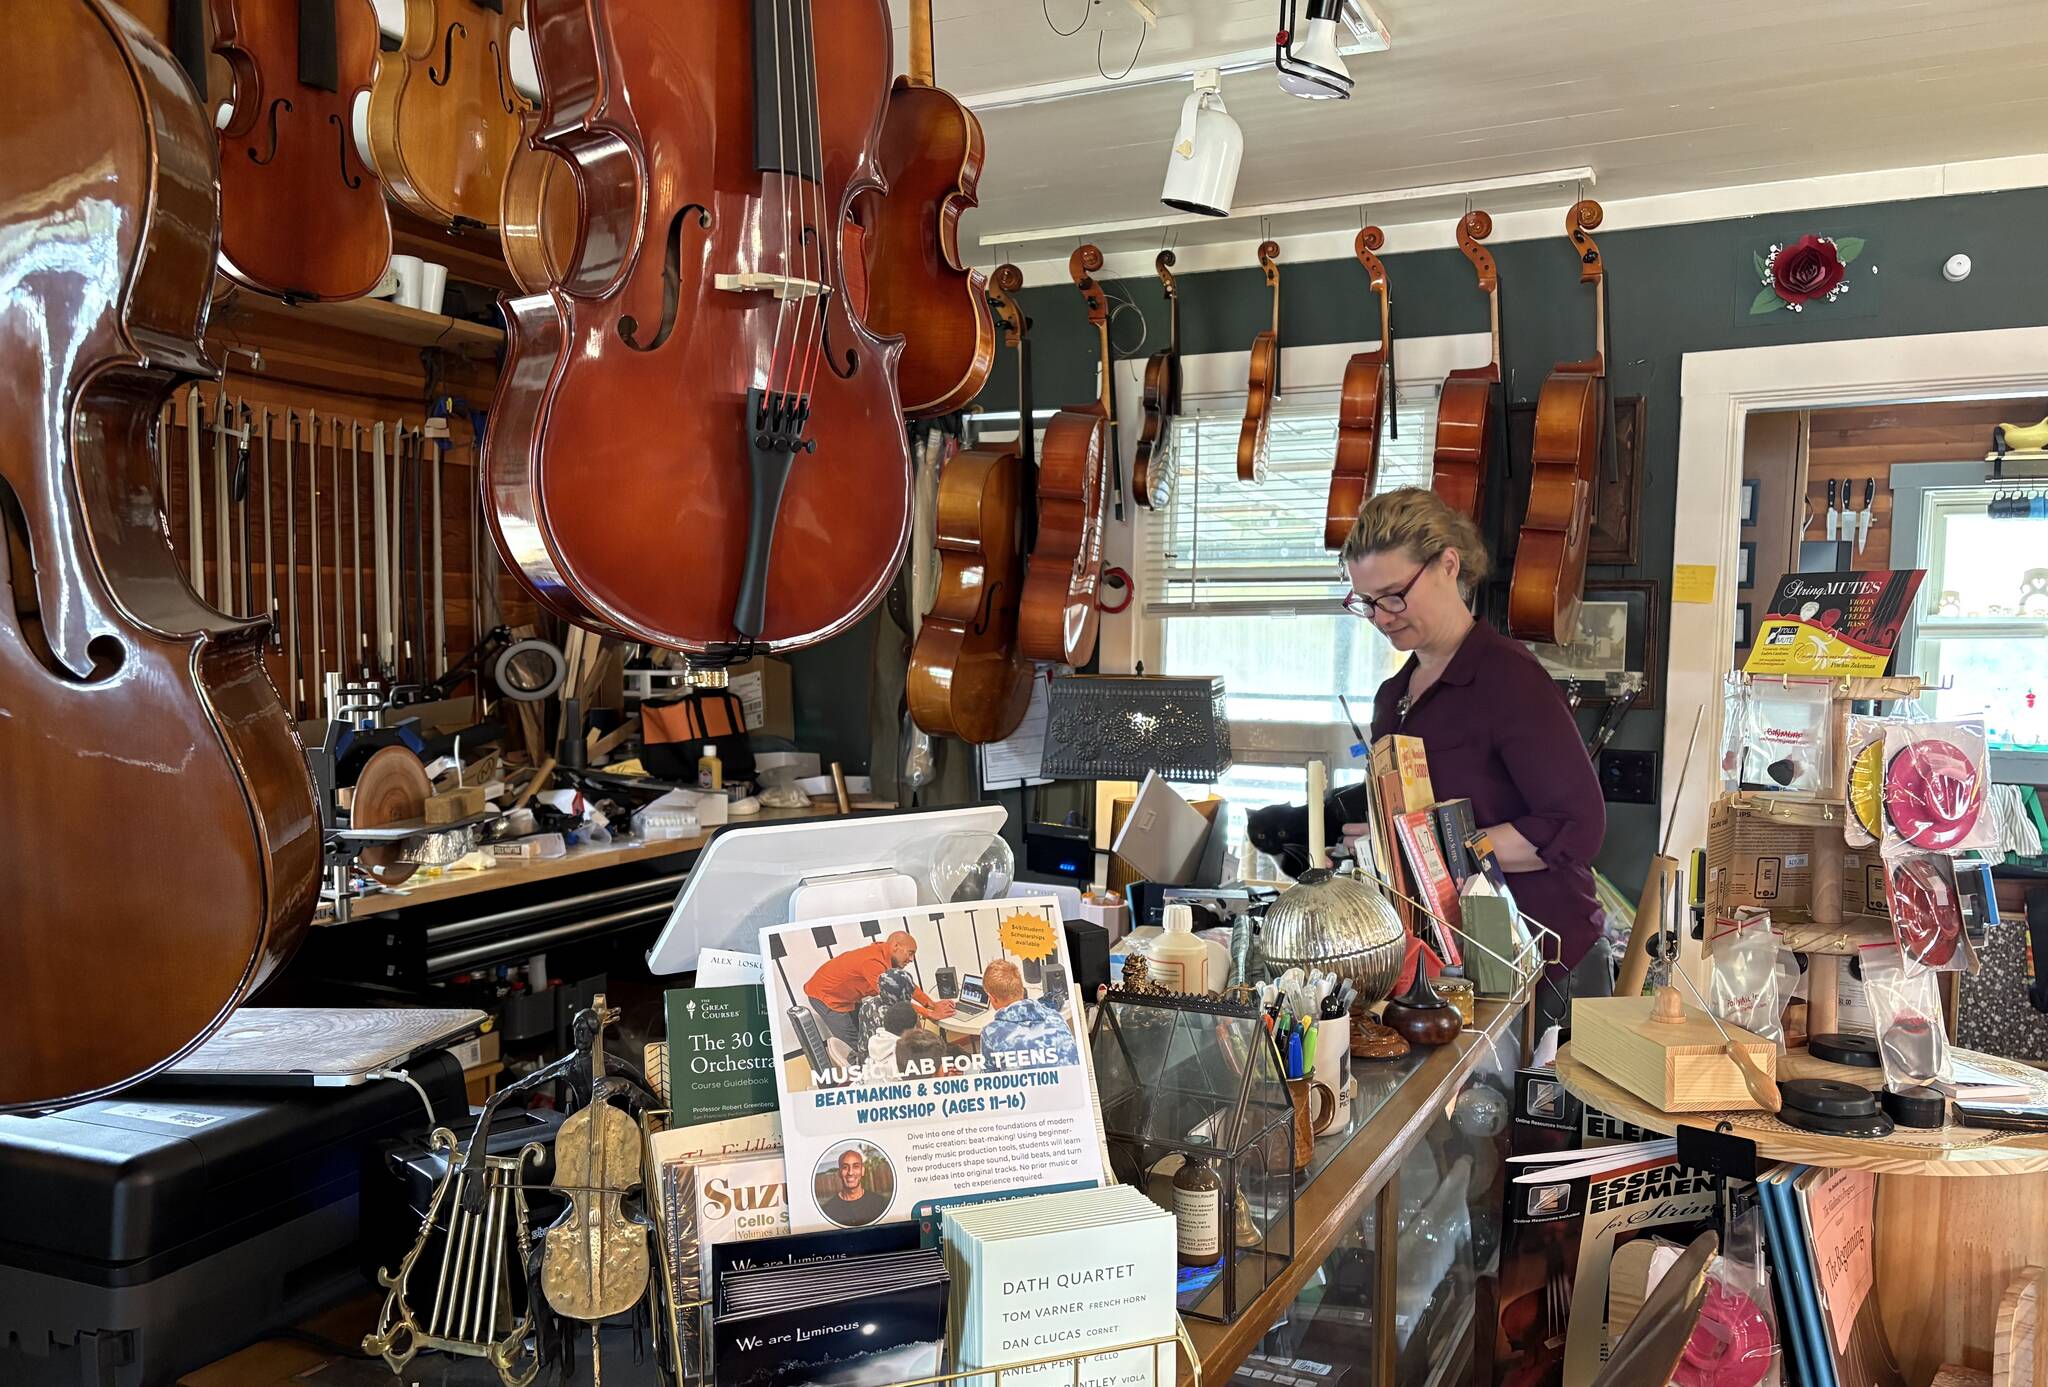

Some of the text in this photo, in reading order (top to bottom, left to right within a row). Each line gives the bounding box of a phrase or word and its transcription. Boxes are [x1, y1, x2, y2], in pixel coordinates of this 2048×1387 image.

[1011, 932, 1045, 941] Scholarships
[710, 957, 732, 966] ALEX
[688, 1034, 726, 1052] The
[731, 1032, 753, 1050] 30
[893, 1057, 937, 1081] LAB
[941, 1054, 986, 1075] FOR
[990, 1048, 1060, 1069] TEENS
[691, 1077, 769, 1091] Course Guidebook
[815, 1071, 1059, 1107] BEATMAKING & SONG PRODUCTION
[692, 1106, 720, 1114] Professor
[743, 1101, 774, 1110] Greenberg
[856, 1102, 935, 1124] WORKSHOP
[942, 1096, 985, 1118] (AGES
[907, 1131, 924, 1140] Dive
[925, 1130, 940, 1138] into
[995, 1121, 1037, 1131] foundations
[1047, 1117, 1074, 1126] modern
[1516, 1117, 1578, 1131] Online Resources Included
[905, 1151, 932, 1162] friendly
[934, 1150, 957, 1158] music
[959, 1145, 997, 1157] production
[999, 1143, 1018, 1152] tools,
[1019, 1140, 1049, 1149] students
[913, 1128, 1072, 1151] music creation: beat-making! Using beginner-
[907, 1164, 923, 1173] how
[925, 1160, 962, 1171] producers
[963, 1158, 984, 1167] shape
[986, 1155, 1010, 1164] sound,
[1012, 1152, 1029, 1161] build
[1031, 1149, 1051, 1158] beats,
[1053, 1148, 1065, 1156] and
[914, 1175, 928, 1184] raw
[930, 1172, 949, 1181] ideas
[951, 1170, 965, 1178] into
[966, 1167, 994, 1177] original
[995, 1165, 1018, 1174] tracks.
[1031, 1161, 1047, 1171] prior
[1048, 1159, 1069, 1168] music
[954, 1173, 1044, 1189] tech experience required.
[1590, 1163, 1706, 1200] ESSEN
[1590, 1177, 1726, 1214] ELEMEN
[737, 1214, 775, 1228] Cello
[1531, 1215, 1559, 1223] Resources
[1559, 1211, 1581, 1220] Included
[1627, 1201, 1717, 1227] Strin
[738, 1229, 773, 1240] Volumes
[1826, 1257, 1838, 1287] The
[1835, 1225, 1865, 1272] Beginning
[1003, 1264, 1135, 1295] DATH QUARTET
[1003, 1294, 1146, 1323] TOM VARNER FRENCH HORN
[735, 1320, 860, 1352] We are Luminous
[1003, 1326, 1119, 1350] DAN CLUCAS CORNET
[1094, 1352, 1119, 1362] CELLO
[1064, 1374, 1146, 1387] NTLEY VIOLA
